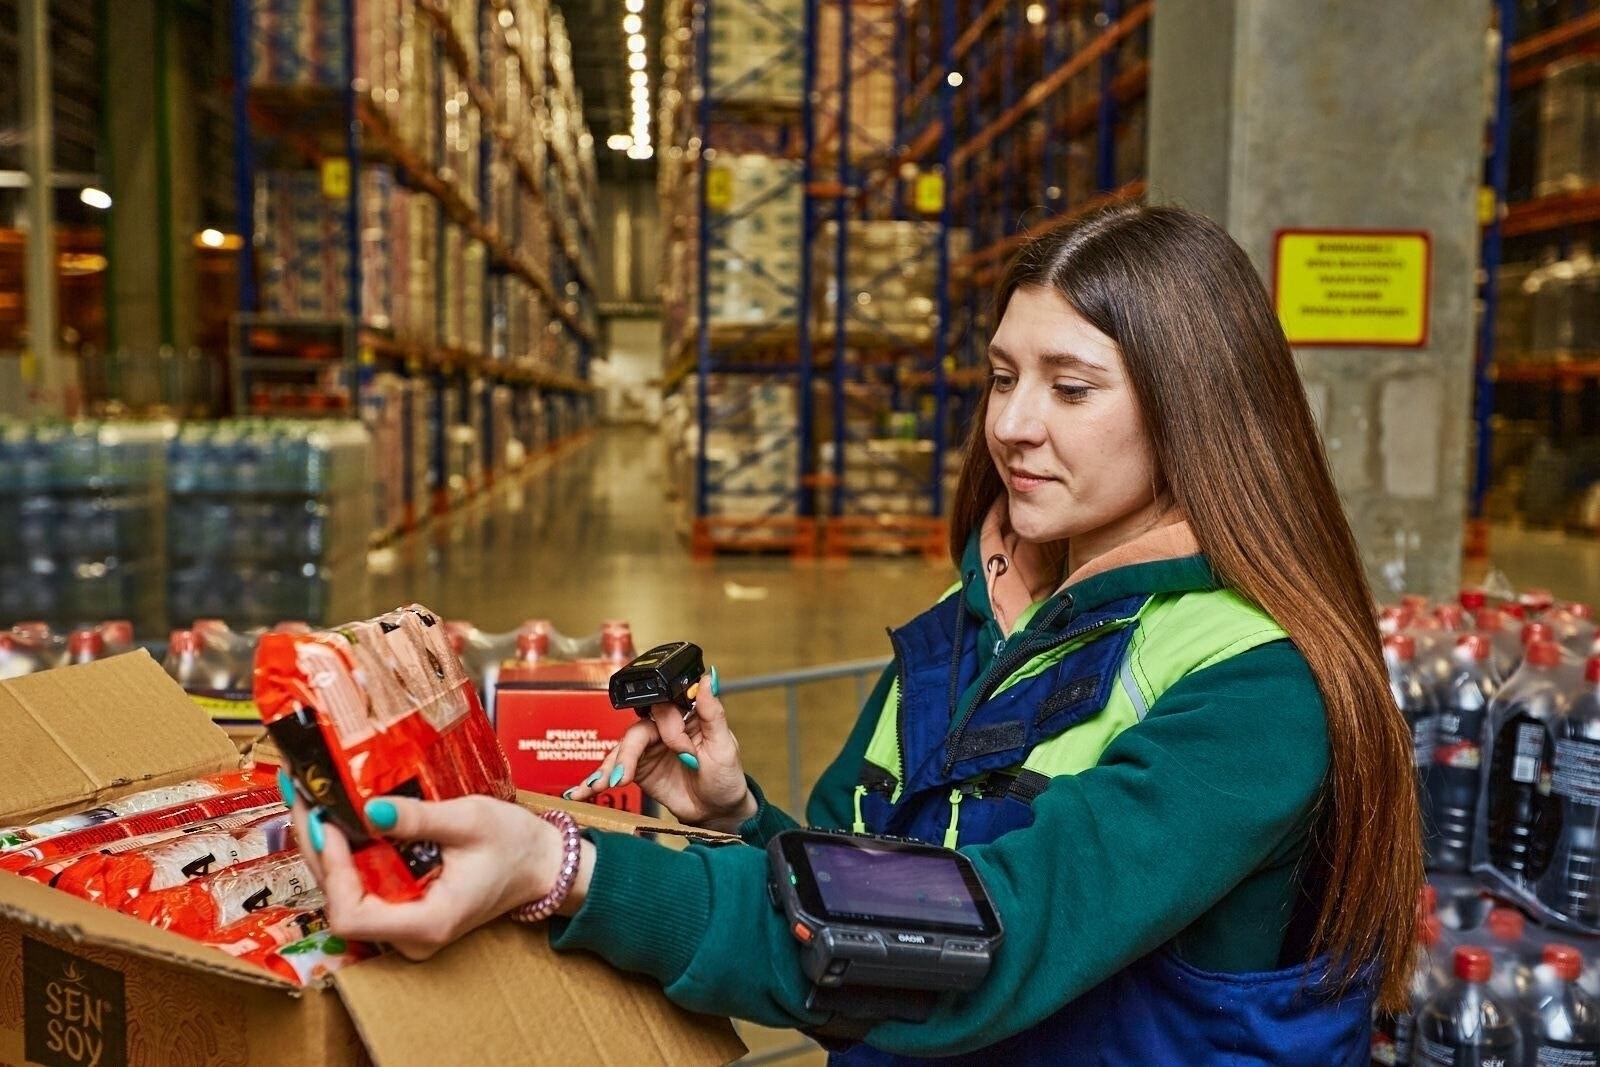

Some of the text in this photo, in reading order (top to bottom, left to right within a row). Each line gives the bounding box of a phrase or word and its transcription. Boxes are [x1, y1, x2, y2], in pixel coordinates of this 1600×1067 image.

[518, 739, 620, 751] АНИРОВОЧНЫЕ
[45, 982, 103, 1035] SEN
[46, 1019, 104, 1067] SOY
